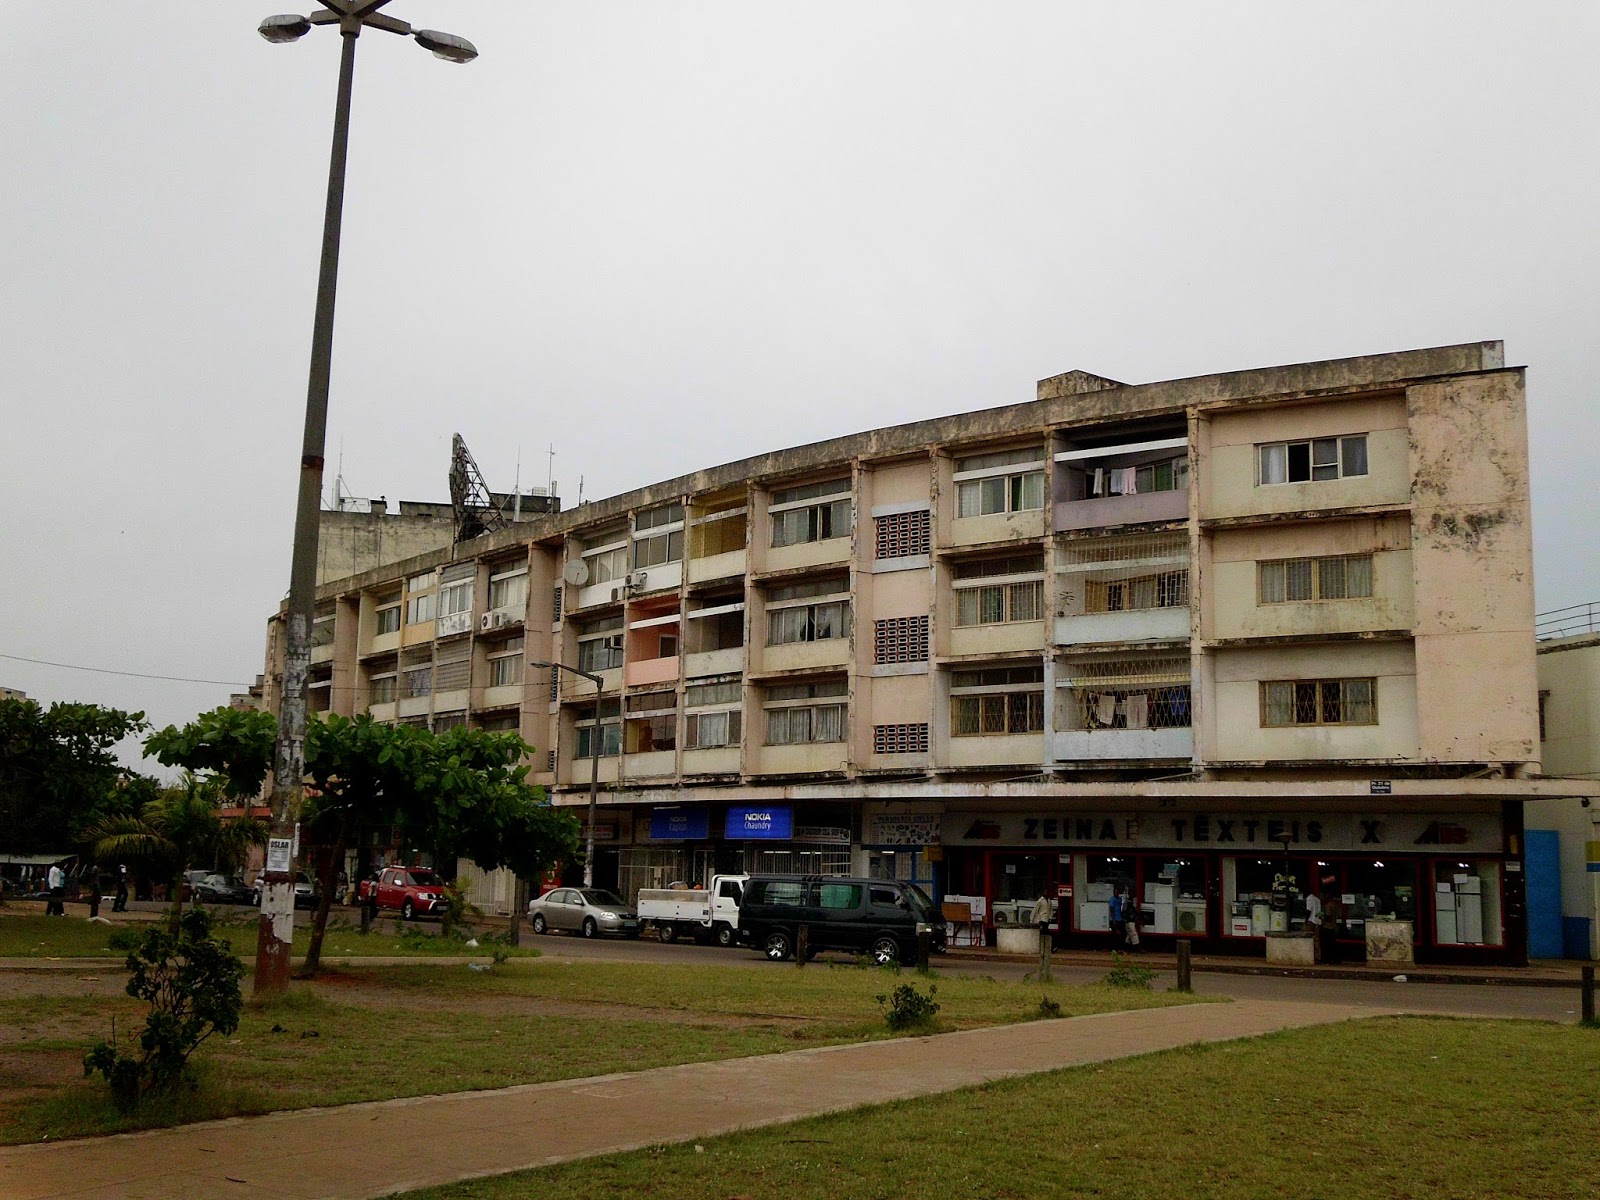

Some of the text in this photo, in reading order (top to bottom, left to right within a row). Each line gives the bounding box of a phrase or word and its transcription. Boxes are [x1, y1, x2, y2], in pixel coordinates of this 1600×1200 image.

[745, 813, 772, 821] NOKIA
[745, 821, 772, 831] Chaundry
[1024, 818, 1118, 840] ZEINA
